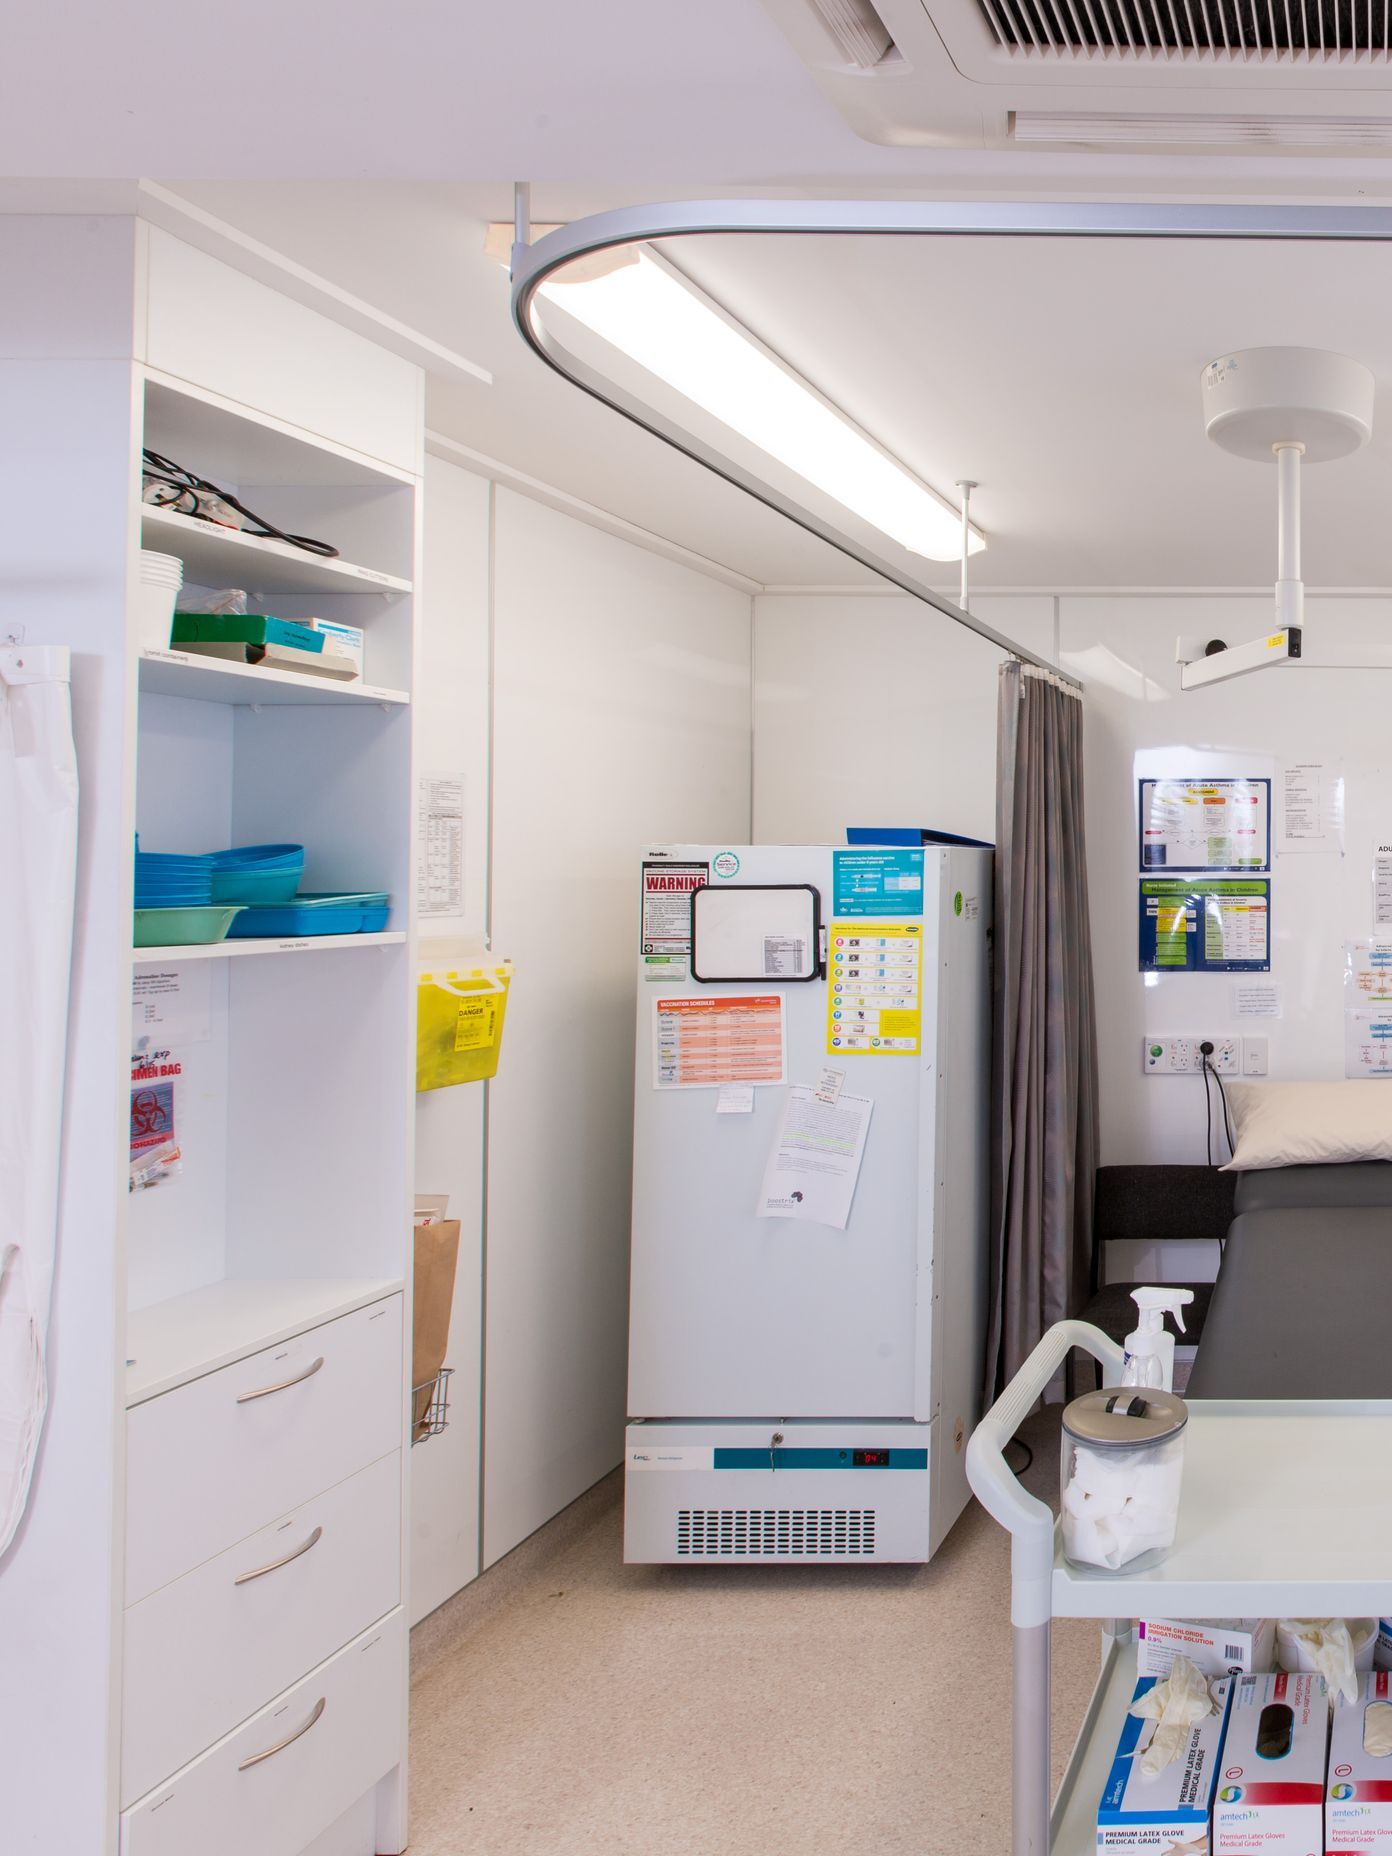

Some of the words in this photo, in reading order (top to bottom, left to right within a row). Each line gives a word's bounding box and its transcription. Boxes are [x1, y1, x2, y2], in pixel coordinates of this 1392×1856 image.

[646, 877, 706, 890] WARNING
[459, 1008, 483, 1016] DANGER
[161, 1063, 182, 1076] BAG
[1148, 1629, 1182, 1640] IRRIGATION
[1184, 1636, 1214, 1646] SOLUTION
[1149, 1623, 1172, 1632] SODIUM
[1173, 1628, 1204, 1638] CHLORIDE
[1302, 1708, 1310, 1725] Gloves
[1191, 1729, 1201, 1748] GLOVE
[1187, 1749, 1197, 1770] LATEX
[1188, 1772, 1200, 1803] MEDICAL
[1194, 1749, 1205, 1772] GRADE
[1112, 1780, 1124, 1804] amtech
[1179, 1770, 1192, 1803] PREMIUM
[1220, 1811, 1248, 1820] amtech
[1332, 1808, 1360, 1817] amtech
